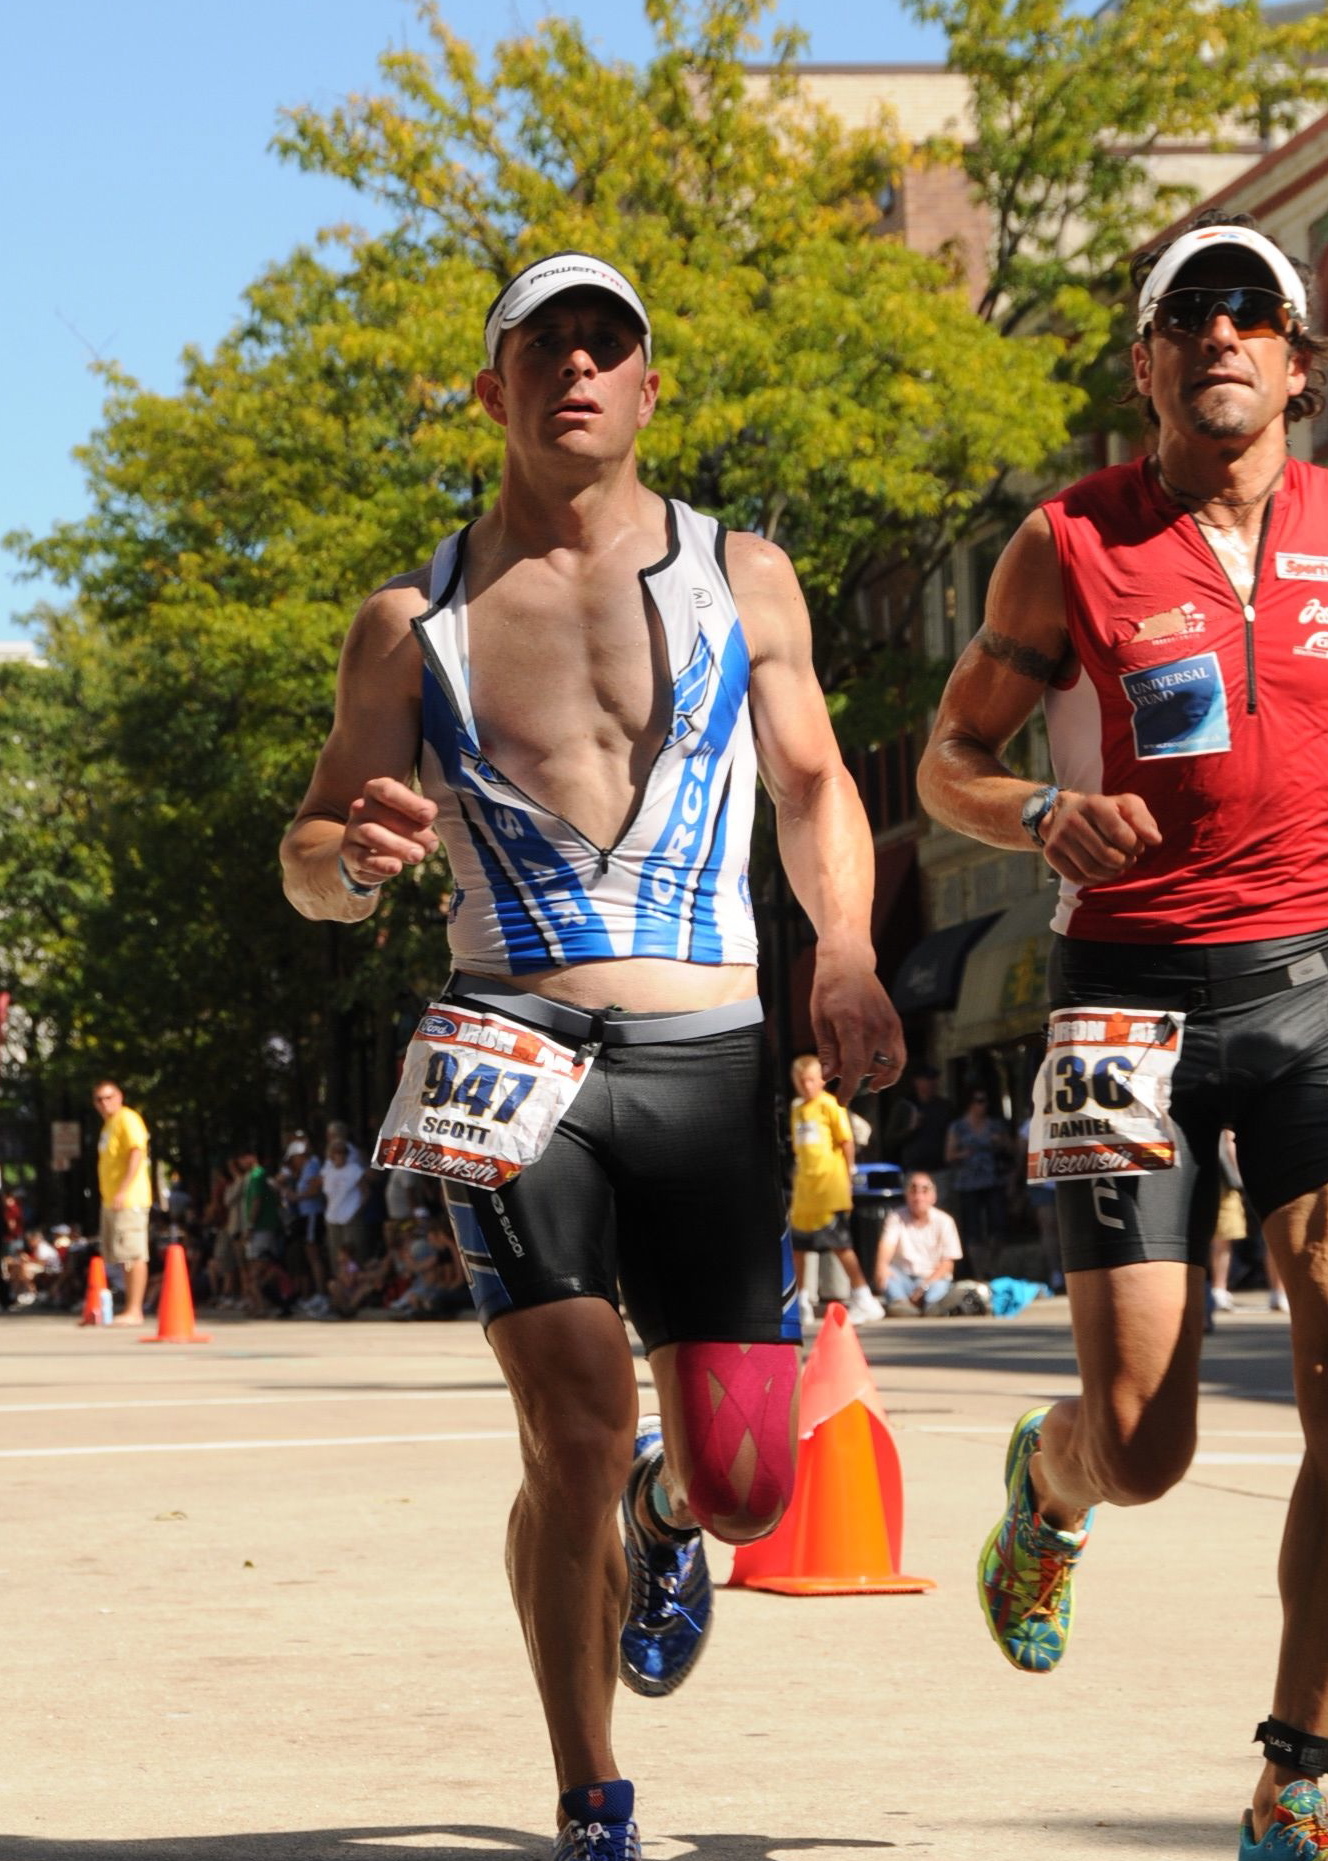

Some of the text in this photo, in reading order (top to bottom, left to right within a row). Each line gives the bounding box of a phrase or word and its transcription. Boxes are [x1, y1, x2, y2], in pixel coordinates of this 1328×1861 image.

[1131, 667, 1210, 694] UNIVERSAL
[1136, 689, 1175, 706] FUND
[420, 1018, 449, 1036] Ford
[420, 1051, 537, 1124] 947
[422, 1116, 491, 1145] SCOTT
[1050, 1119, 1115, 1139] DANIEL
[398, 1139, 500, 1183] Wisconsin
